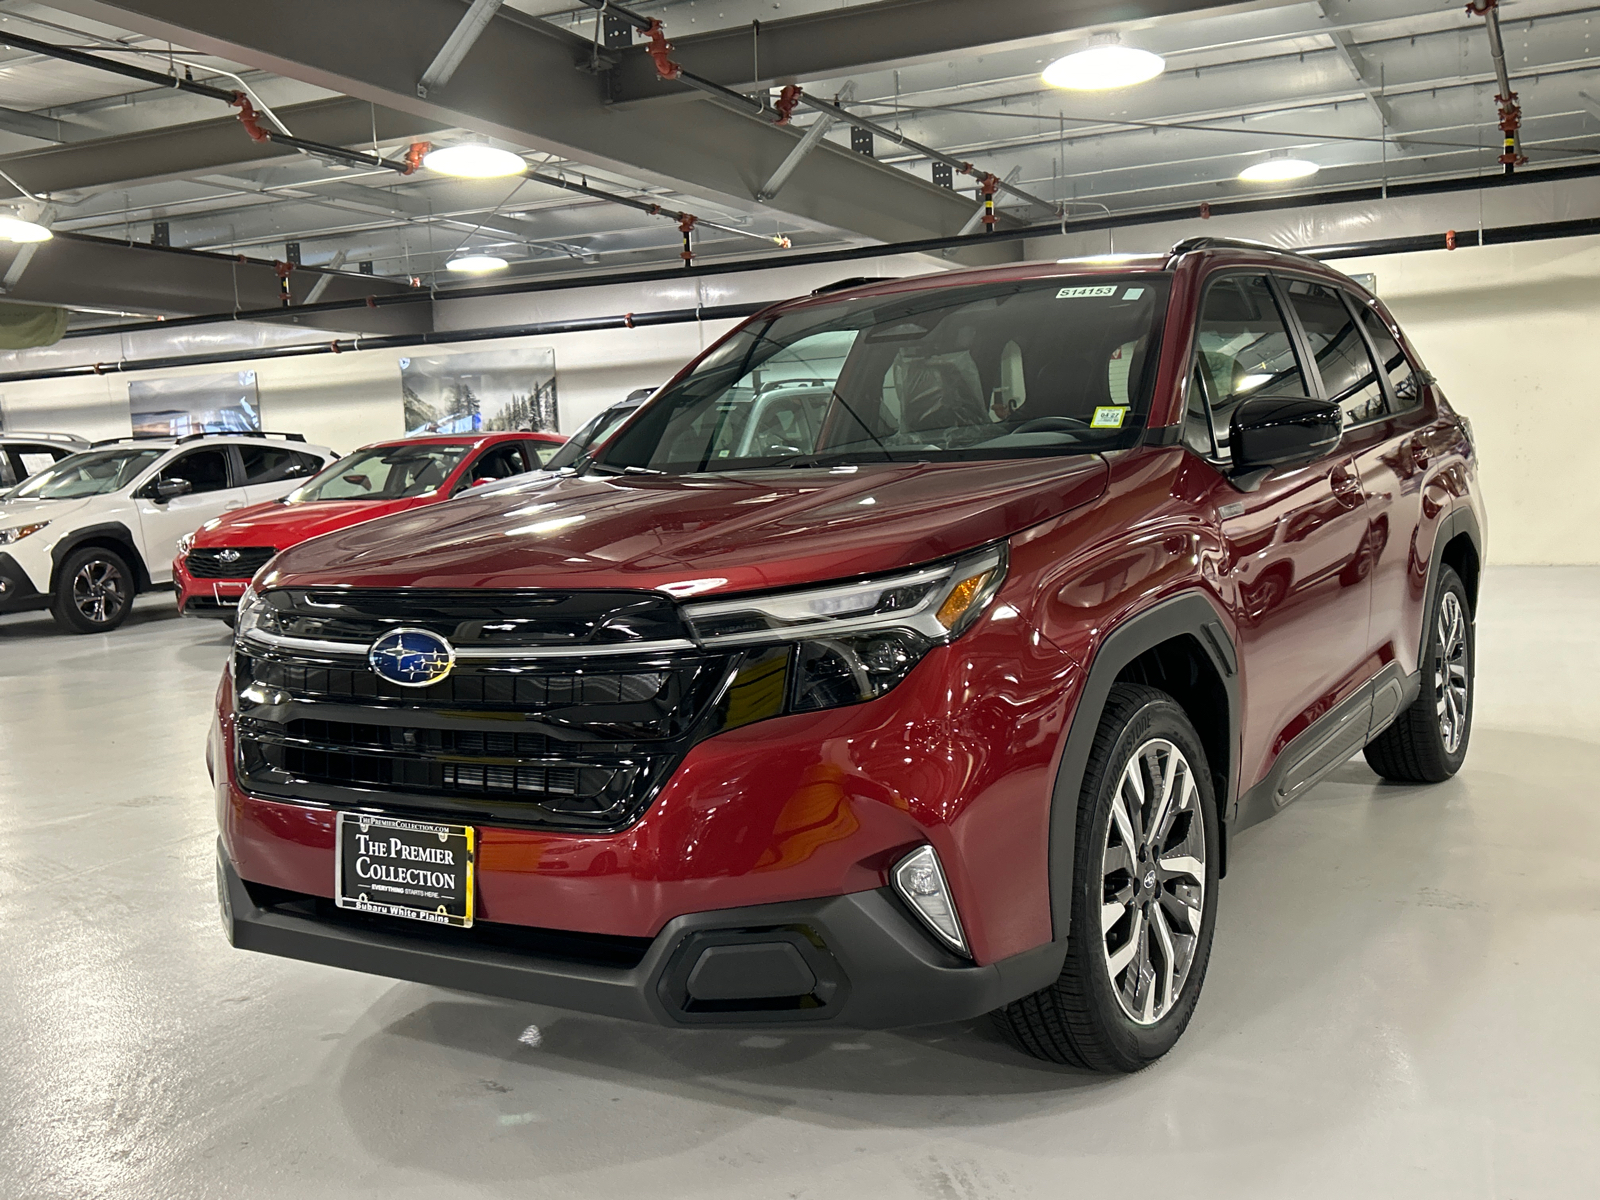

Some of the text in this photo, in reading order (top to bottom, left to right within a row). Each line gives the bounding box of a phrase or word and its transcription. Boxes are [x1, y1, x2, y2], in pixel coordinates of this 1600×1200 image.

[1060, 287, 1112, 297] S14153
[371, 883, 404, 895] EVERYTHING
[404, 886, 424, 897] STARTS
[355, 901, 450, 924] Subaru White Plains
